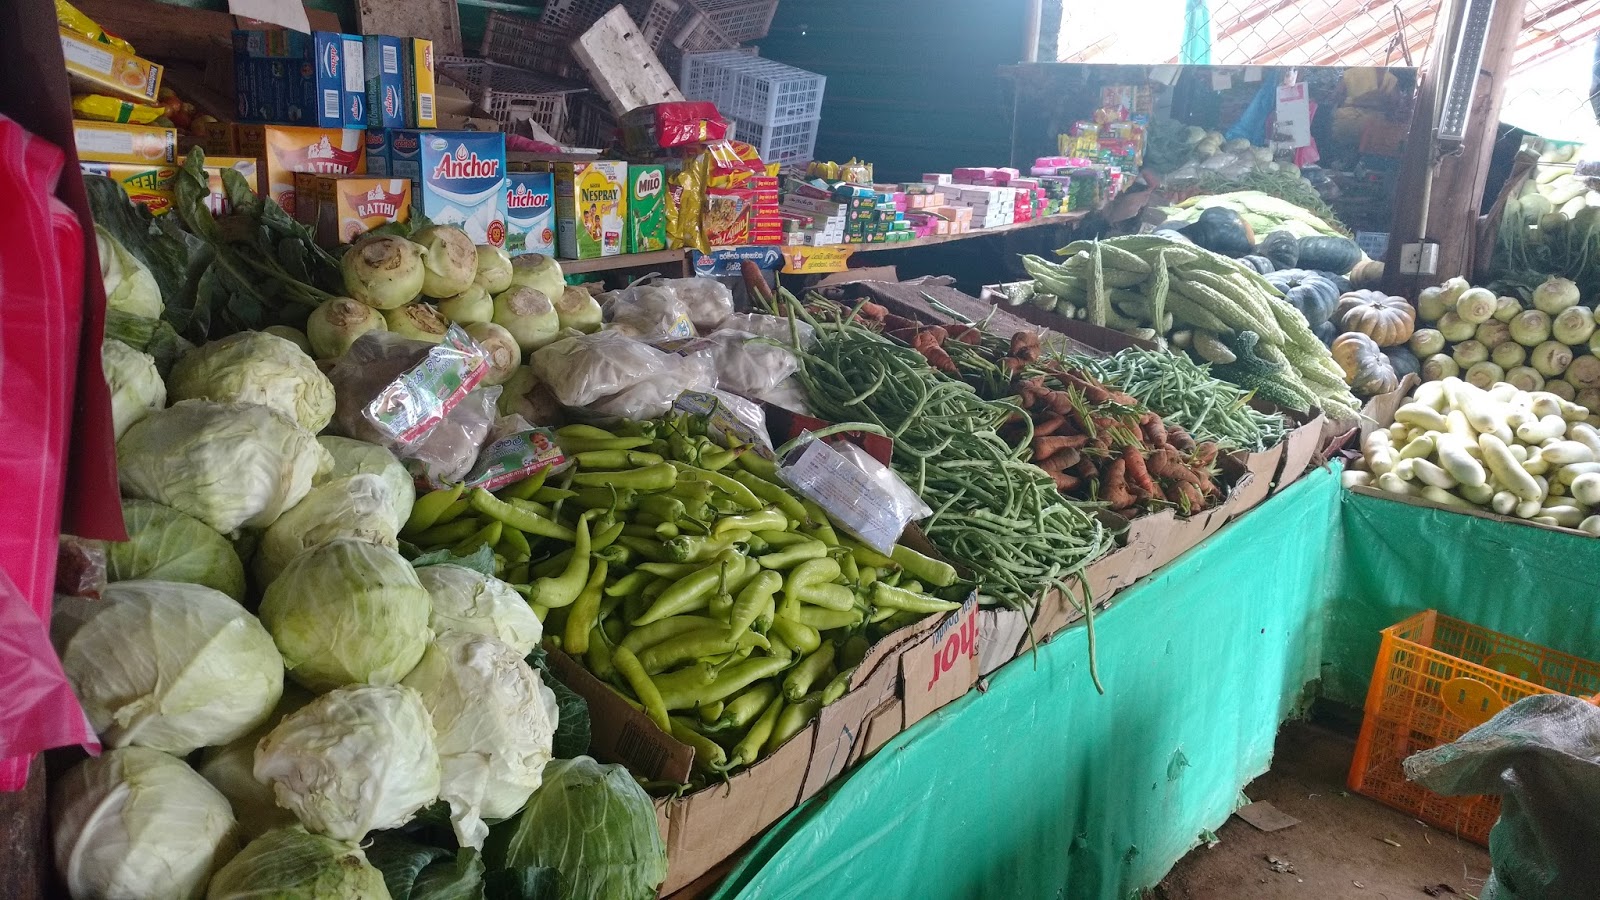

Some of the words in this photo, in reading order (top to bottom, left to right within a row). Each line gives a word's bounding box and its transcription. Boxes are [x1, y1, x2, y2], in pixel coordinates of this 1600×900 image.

[330, 44, 338, 76] Anchor
[432, 152, 499, 180] Anchor
[582, 188, 619, 202] NESPRAY
[638, 177, 660, 193] MILO
[506, 188, 549, 209] Anchor
[358, 202, 396, 217] RATTHI
[928, 606, 980, 692] hor
